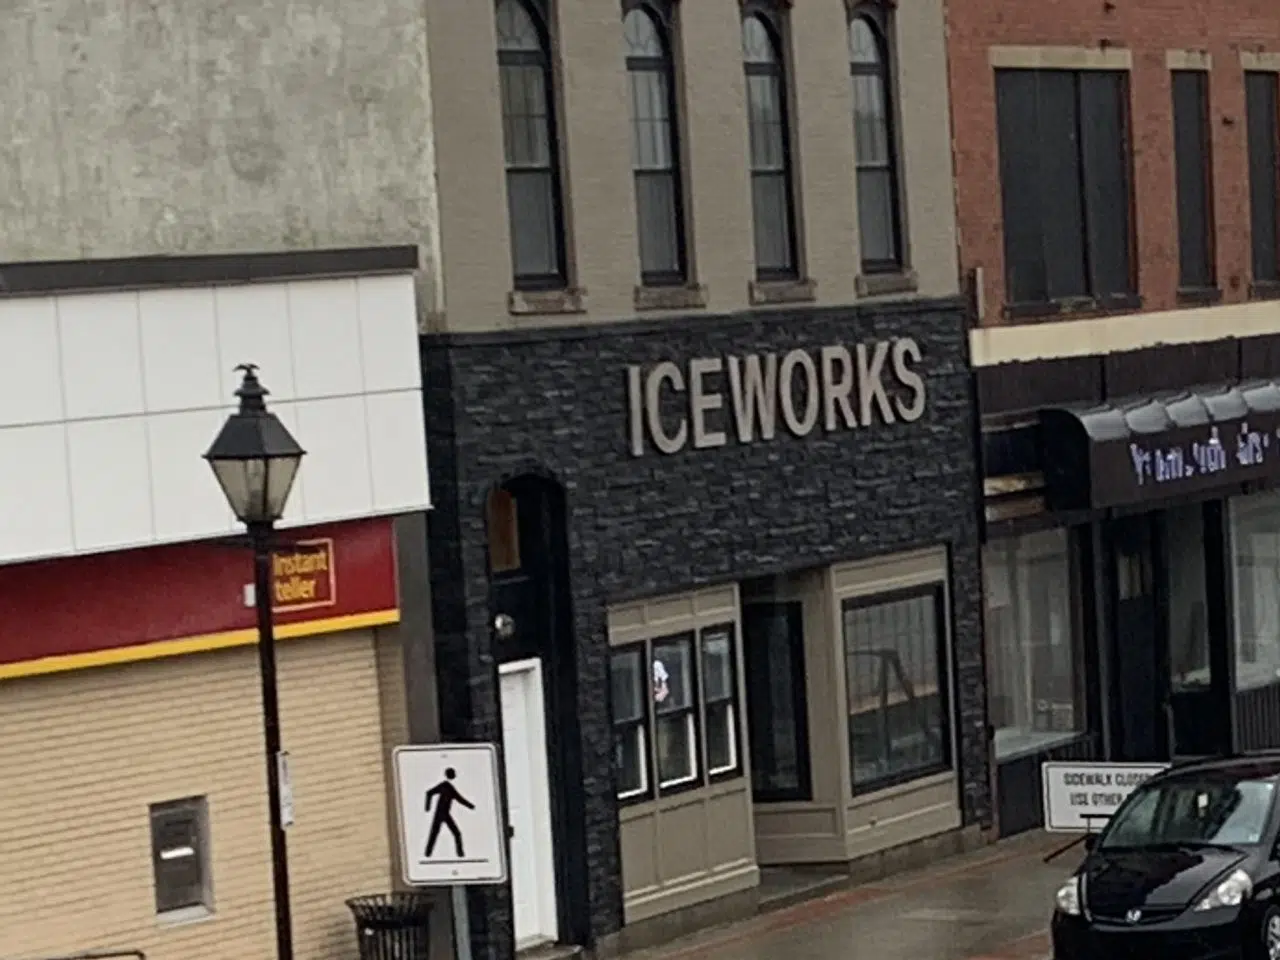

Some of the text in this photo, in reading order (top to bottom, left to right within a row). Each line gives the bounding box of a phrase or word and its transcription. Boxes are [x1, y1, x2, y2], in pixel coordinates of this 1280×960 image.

[627, 336, 926, 456] ICEWORKS
[1063, 772, 1113, 786] SIDEWALK
[1069, 793, 1089, 806] USE
